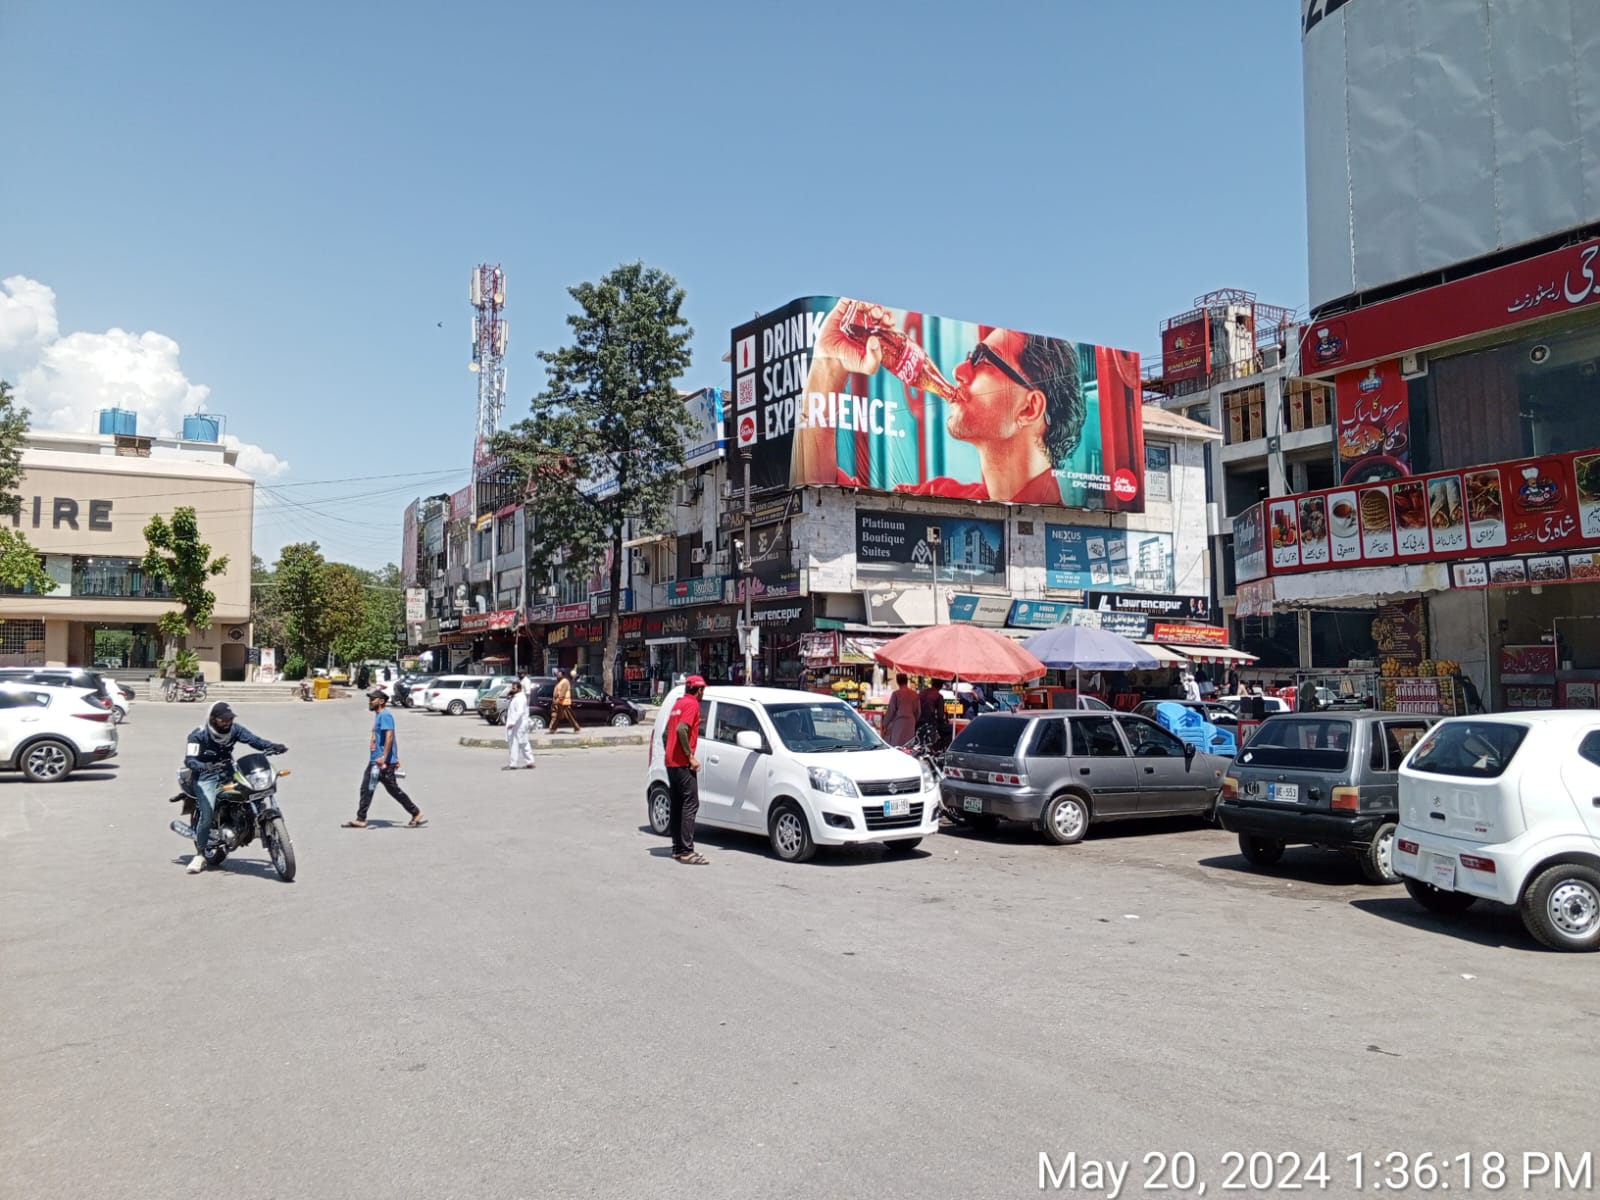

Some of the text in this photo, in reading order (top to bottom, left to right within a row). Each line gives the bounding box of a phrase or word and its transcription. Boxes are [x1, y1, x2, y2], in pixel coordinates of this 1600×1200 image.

[763, 312, 825, 363] DRINK
[763, 353, 807, 401] SCAN
[765, 392, 905, 440] EXPERIENCE.
[1051, 469, 1110, 482] EPIC EXPERIENCES
[1072, 480, 1111, 491] EPIC PRIZES
[862, 517, 905, 530] Platinum
[862, 532, 905, 546] Boutique
[1052, 530, 1081, 540] NEXUS
[861, 546, 891, 557] Suites
[767, 585, 787, 597] Shoes
